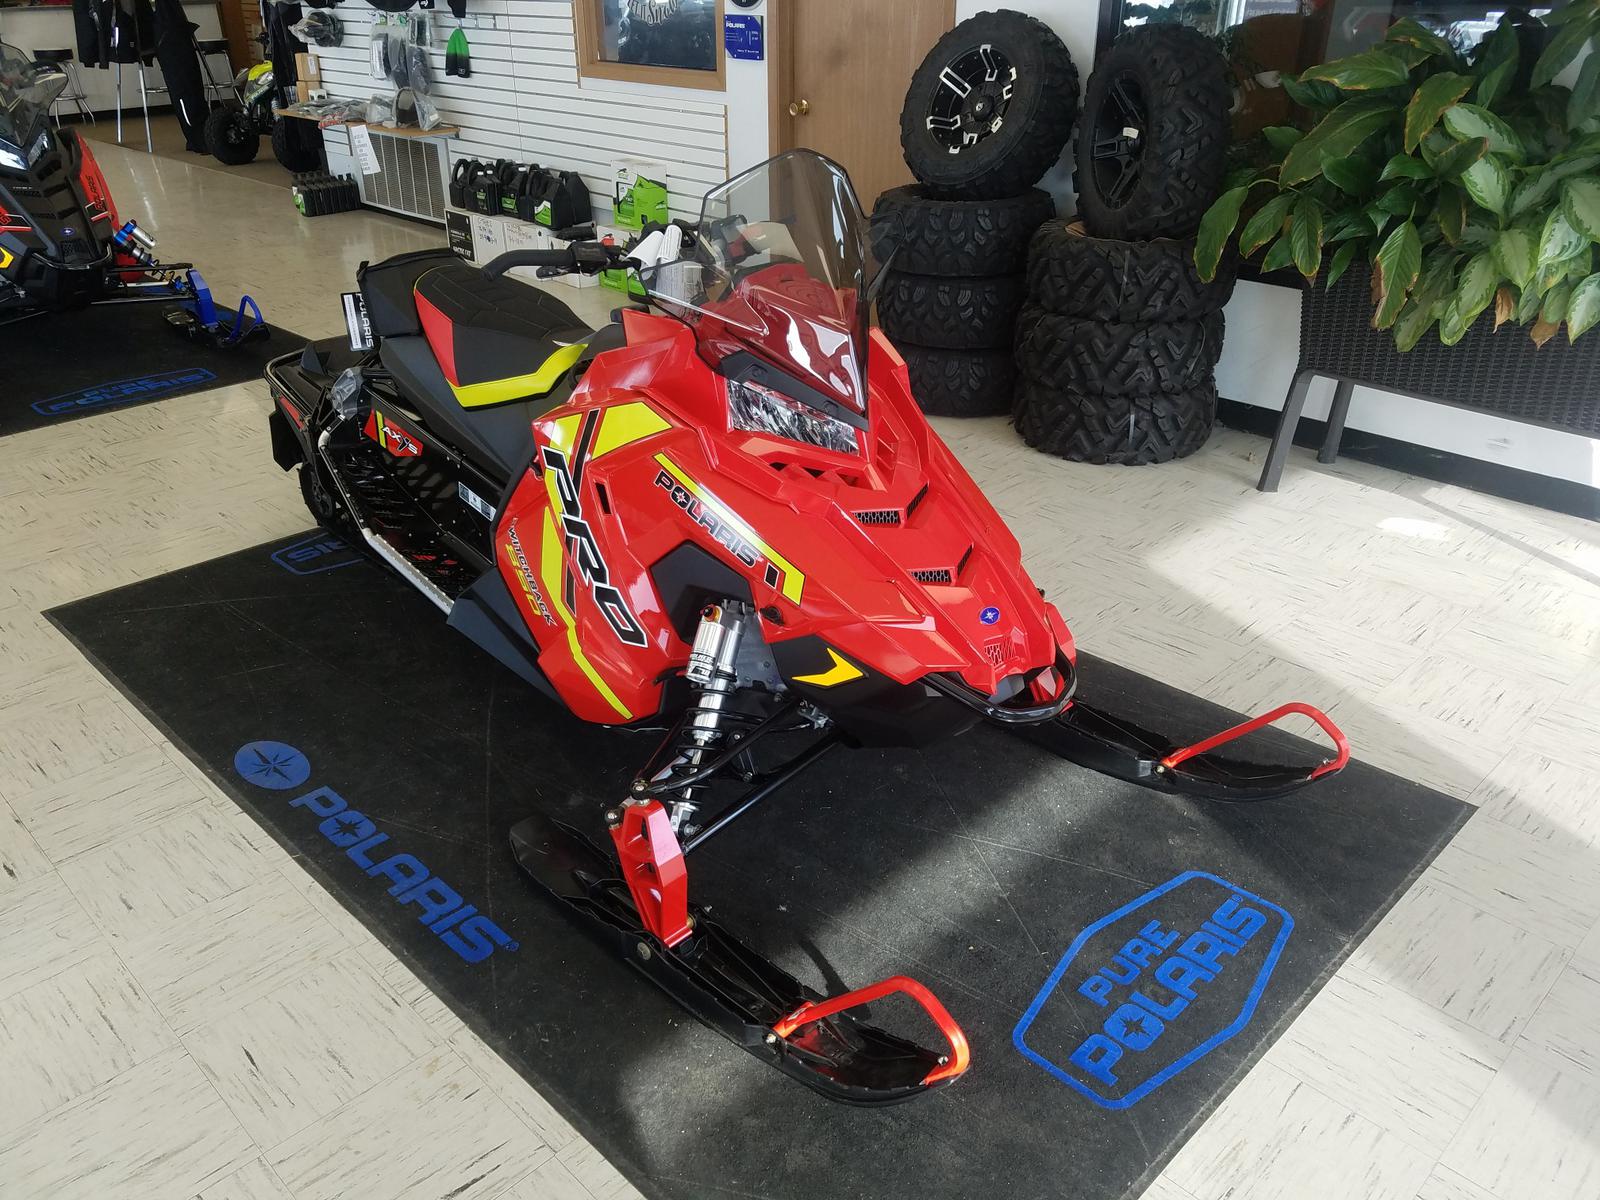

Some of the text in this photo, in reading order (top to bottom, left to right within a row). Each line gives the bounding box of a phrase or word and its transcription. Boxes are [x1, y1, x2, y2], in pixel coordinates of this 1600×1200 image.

[356, 293, 375, 349] POLARIS
[382, 426, 418, 455] AXYS
[541, 445, 648, 648] PRO
[653, 469, 760, 568] POLARIS
[288, 785, 514, 964] POLARIS
[1068, 896, 1267, 1087] POLARIS
[1077, 919, 1181, 1008] PURE
